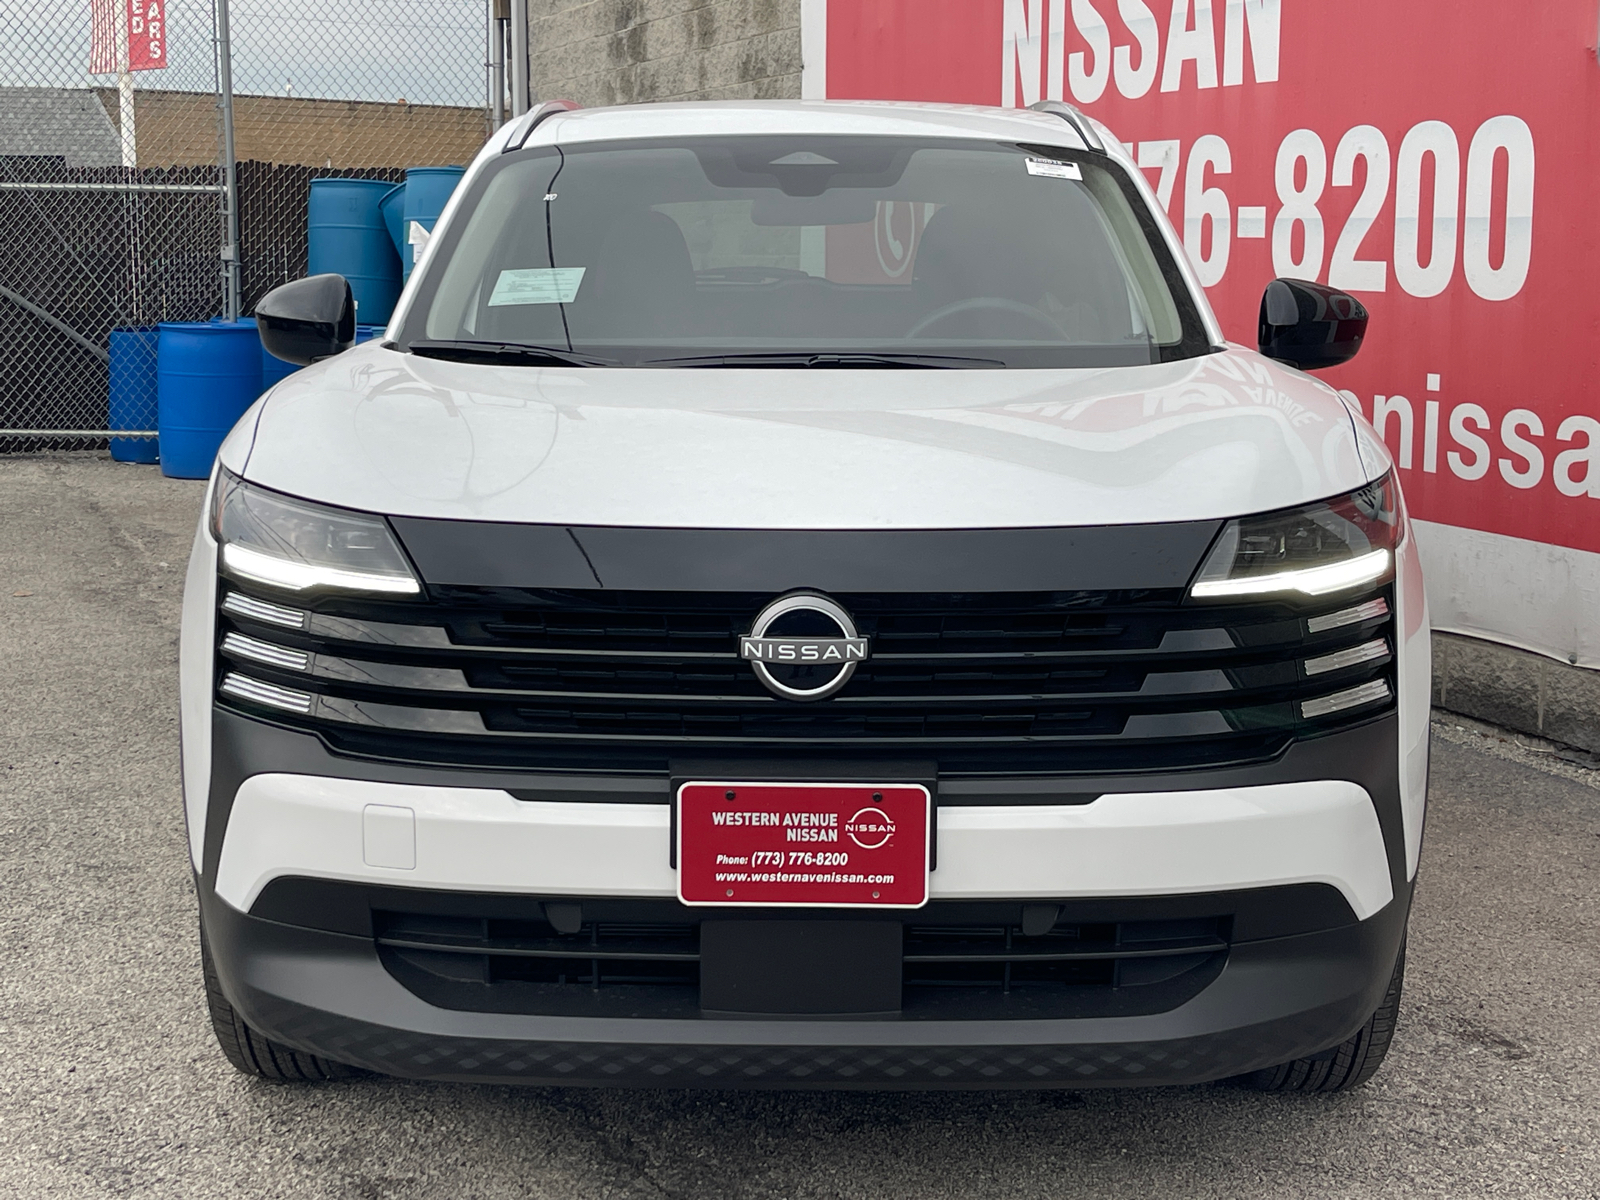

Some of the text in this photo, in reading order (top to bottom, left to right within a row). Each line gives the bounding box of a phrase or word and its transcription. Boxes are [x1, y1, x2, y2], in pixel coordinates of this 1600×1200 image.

[1001, 0, 1281, 109] NISSAN
[1122, 115, 1535, 301] 76-8200
[744, 641, 865, 660] NISSAN
[712, 811, 838, 827] WESTERN AVENUE
[786, 828, 838, 842] NISSAN
[845, 824, 896, 832] NISSAN
[716, 851, 849, 868] Phone: (773) 776-8200
[715, 871, 895, 884] www.westernavenissan.com
